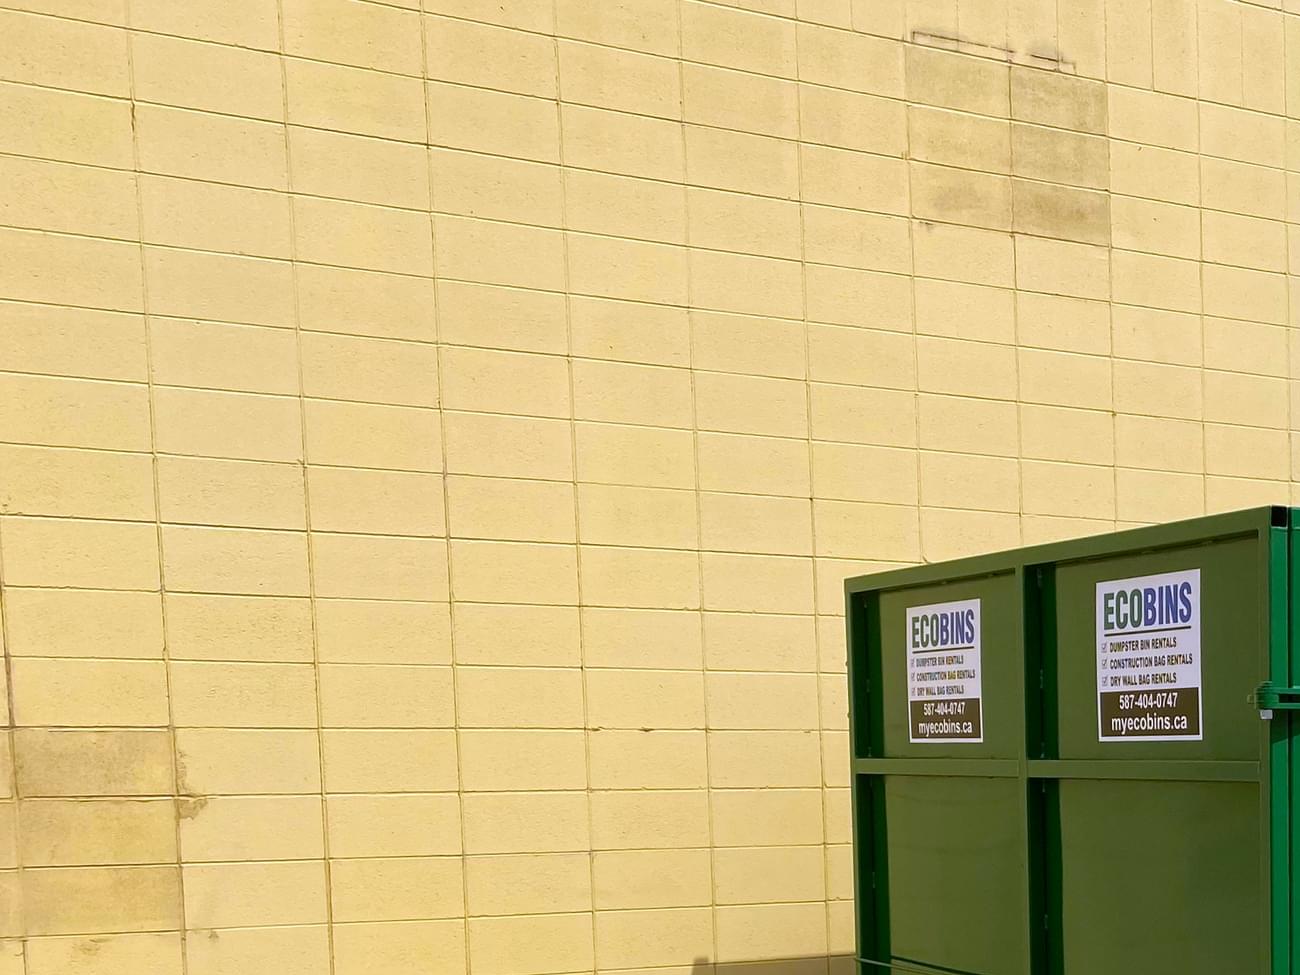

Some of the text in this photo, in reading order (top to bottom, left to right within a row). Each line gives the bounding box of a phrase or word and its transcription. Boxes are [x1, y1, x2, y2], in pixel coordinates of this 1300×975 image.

[1103, 581, 1192, 630] ECOBINS
[912, 609, 974, 648] ECOBINS
[1109, 637, 1177, 653] DUMPSTER BIN RENTALS
[1110, 653, 1193, 670] CONSTRUCTION BAG RENTALS
[917, 669, 976, 681] CONSTRUCTION BAG RENTALS
[1110, 672, 1177, 687] DRY WALL BAG RENTALS
[917, 685, 964, 697] DRY WALL BAG RENTALS
[923, 702, 965, 716] 587-404-0747
[1119, 692, 1178, 710] 587-404-0747
[919, 719, 973, 737] myecobins.ca
[1111, 713, 1187, 735] myecobins.ca
